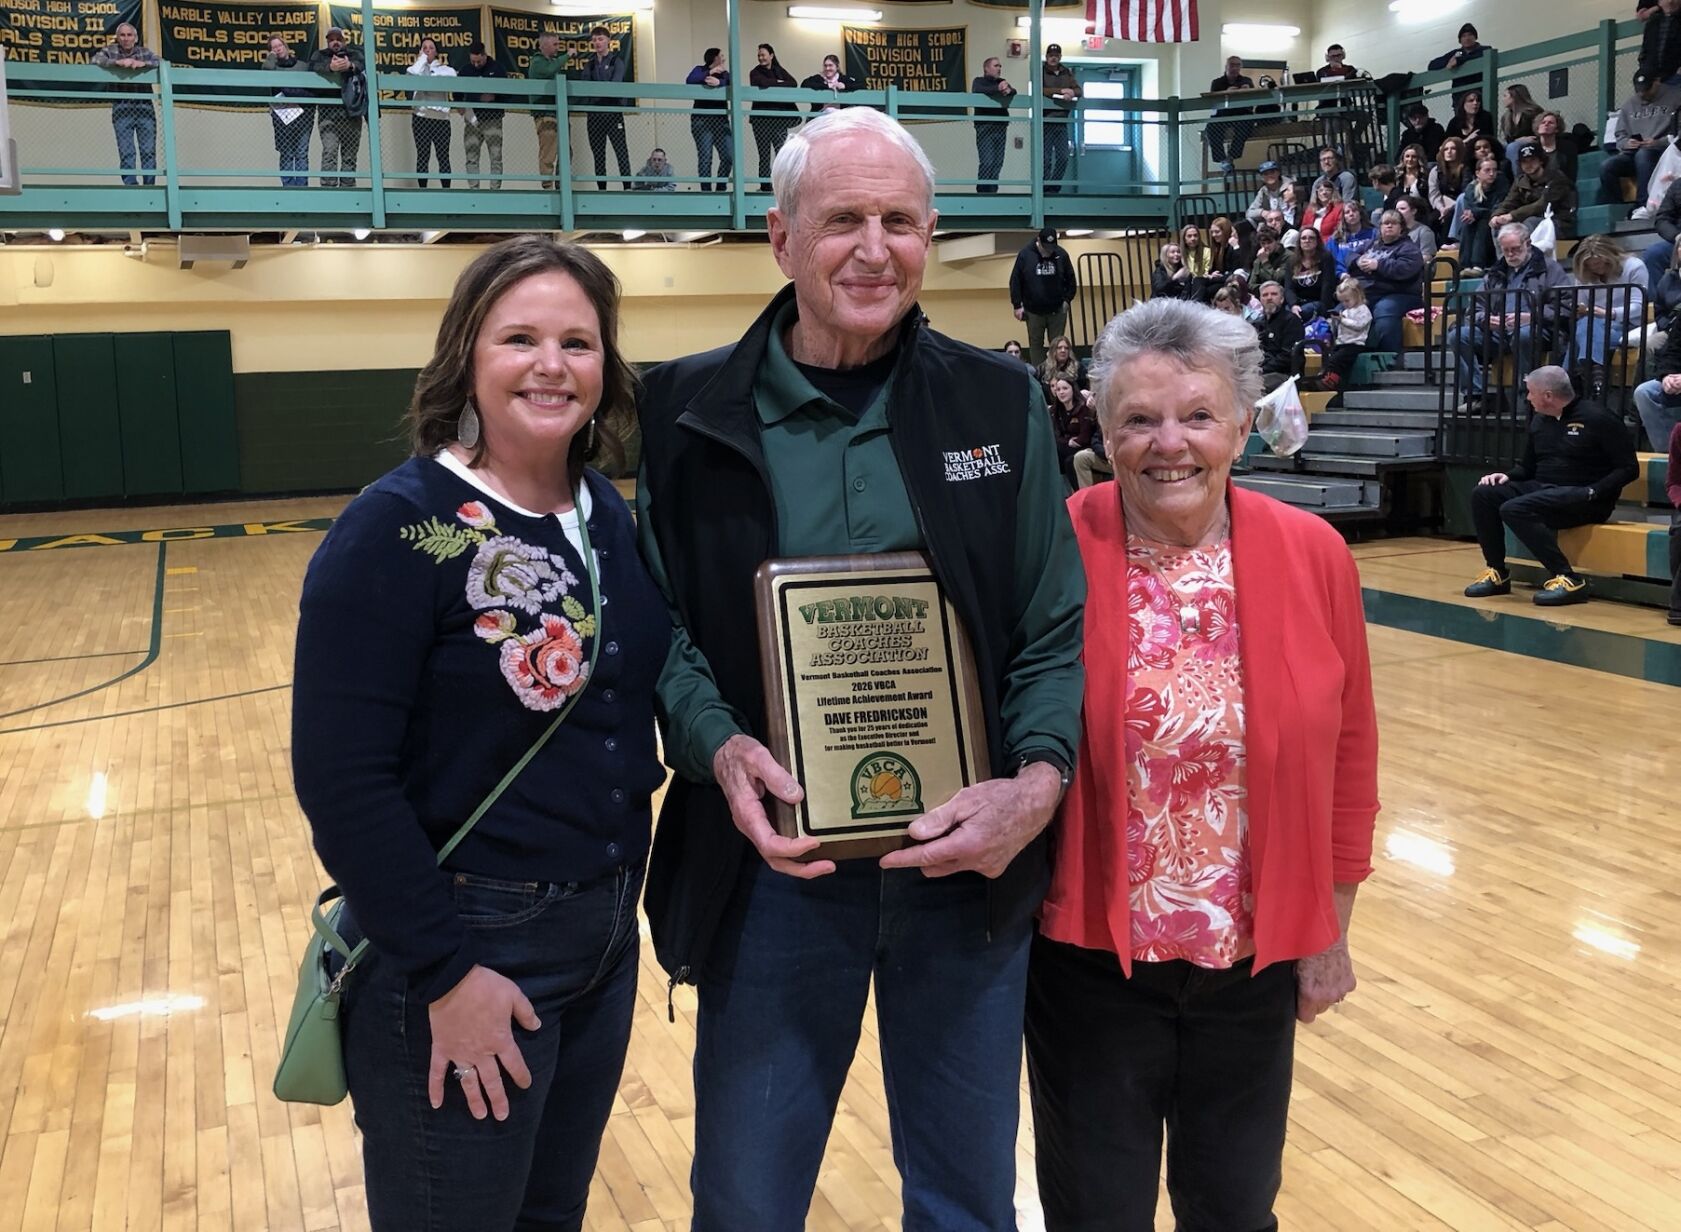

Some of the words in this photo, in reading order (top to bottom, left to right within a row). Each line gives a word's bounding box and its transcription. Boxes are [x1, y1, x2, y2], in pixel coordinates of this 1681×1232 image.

[0, 0, 40, 11] INDSOR
[46, 1, 71, 13] HIGH
[78, 3, 120, 14] SCHOOL
[10, 13, 79, 31] DIVISION
[85, 18, 105, 31] III
[162, 6, 213, 23] MARBLE
[217, 11, 264, 25] VALLEY
[269, 11, 316, 25] LEAGUE
[351, 13, 394, 26] WISOR
[398, 16, 420, 27] HIGH
[424, 17, 461, 27] SCHOOL
[494, 16, 539, 32] MARBLE
[543, 21, 584, 34] VALLEY
[51, 34, 118, 48] SOCCE
[173, 26, 228, 43] GIRLS
[233, 30, 307, 44] SOCER
[342, 29, 387, 47] STE
[845, 29, 887, 46] WINDSOR
[897, 33, 919, 47] HIGH
[928, 32, 963, 47] SCHOOL
[507, 36, 540, 50] BOY
[558, 40, 621, 52] SOCCR
[867, 48, 921, 62] DIVISION
[930, 48, 943, 61] III
[871, 63, 941, 77] FOOTBALL
[903, 78, 947, 91] FINALIST
[944, 455, 1005, 472] BASKETBALL
[945, 469, 981, 482] COACHES
[799, 595, 929, 624] VERMONT
[817, 621, 926, 639] BASKETBALL
[828, 635, 912, 651] COACHES
[810, 647, 929, 667] ASSOCIATION
[801, 672, 831, 681] Vermont
[832, 670, 869, 679] Basketball
[870, 668, 900, 678] Coaches
[902, 666, 942, 675] Association
[852, 681, 873, 692] 2026
[874, 680, 896, 690] VBCA
[817, 695, 851, 706] Lifetime
[852, 692, 906, 705] Achievement
[907, 690, 933, 701] Award
[824, 711, 852, 725] DAVE
[854, 707, 928, 723] FREDRICKSON
[898, 721, 928, 729] dedication
[858, 732, 884, 740] Executive
[885, 731, 908, 739] Director
[834, 743, 855, 751] making
[856, 741, 885, 750] basketball
[886, 739, 903, 747] better
[861, 760, 906, 780] VBCA
